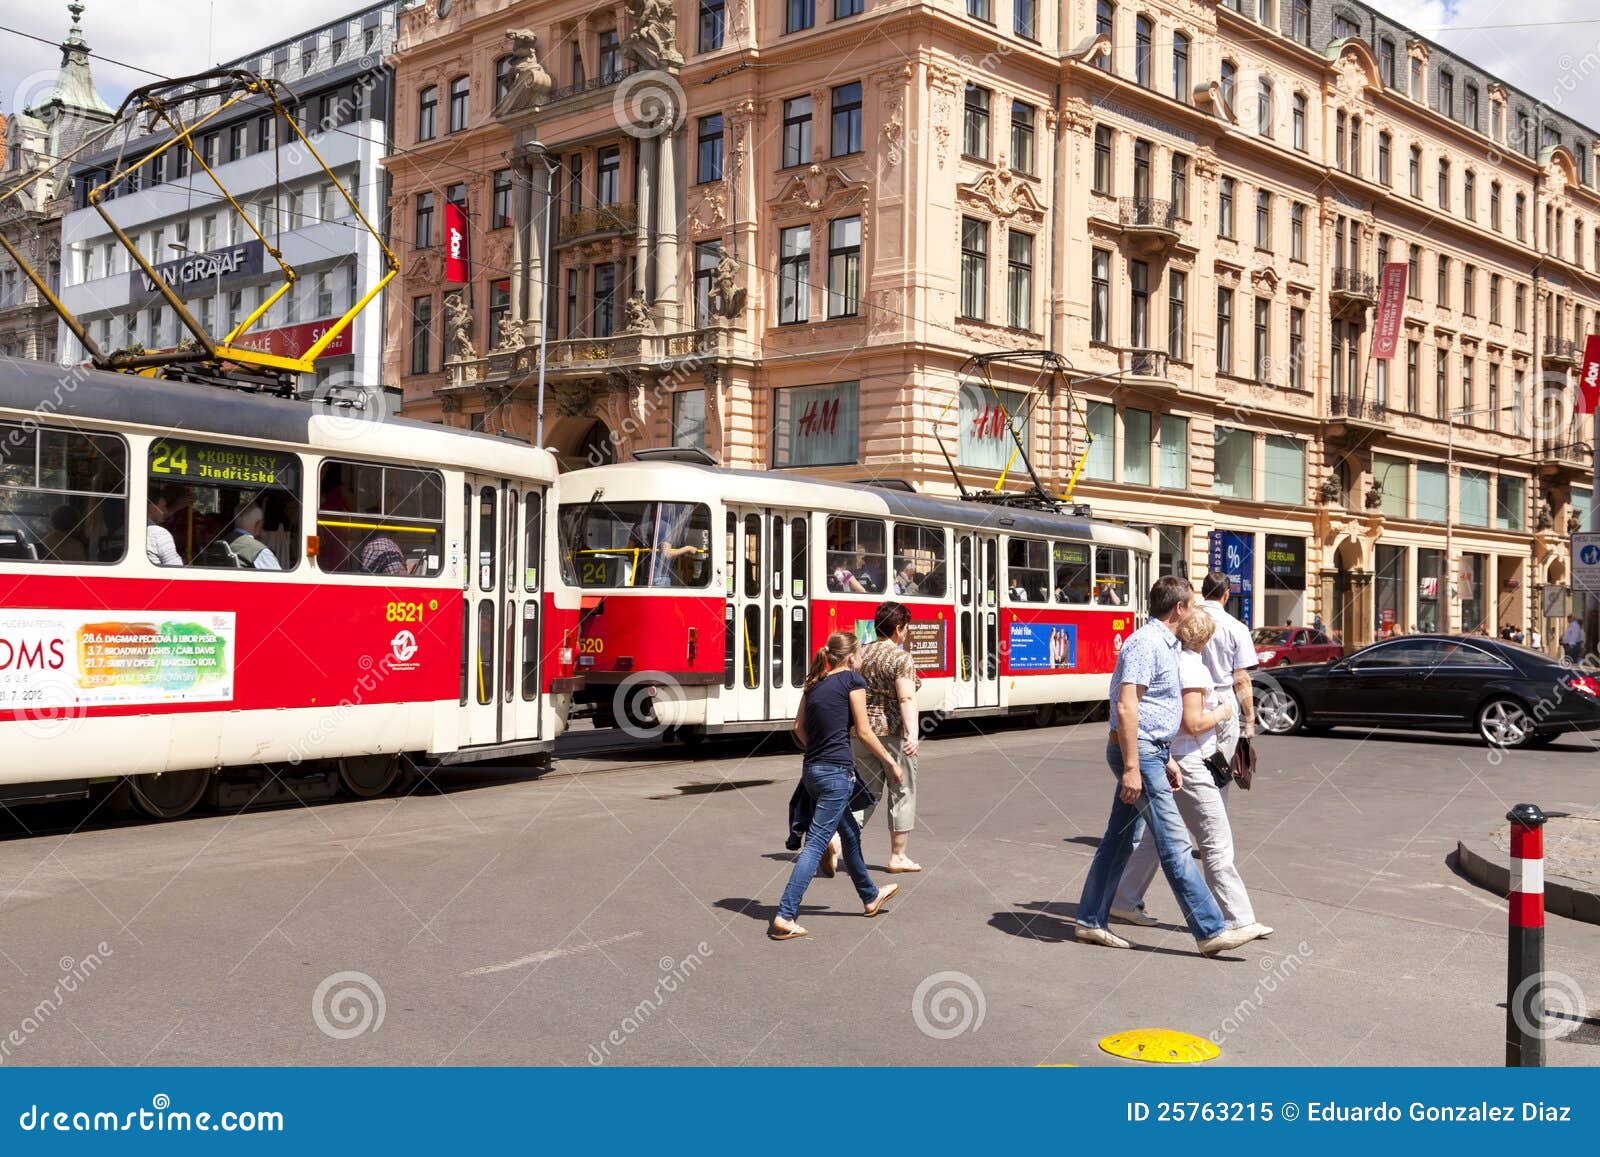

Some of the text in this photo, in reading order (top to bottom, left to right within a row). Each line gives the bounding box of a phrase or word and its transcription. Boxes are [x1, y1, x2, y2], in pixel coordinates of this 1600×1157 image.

[450, 228, 463, 259] AON
[180, 248, 245, 283] GRAAF
[798, 397, 840, 438] H&M
[152, 443, 277, 475] 24 KOBYLISY
[583, 563, 607, 583] 24
[386, 602, 423, 622] 8521
[105, 634, 139, 643] DAGMAR
[105, 646, 147, 655] BROADWAY
[195, 646, 215, 655] DAVIS
